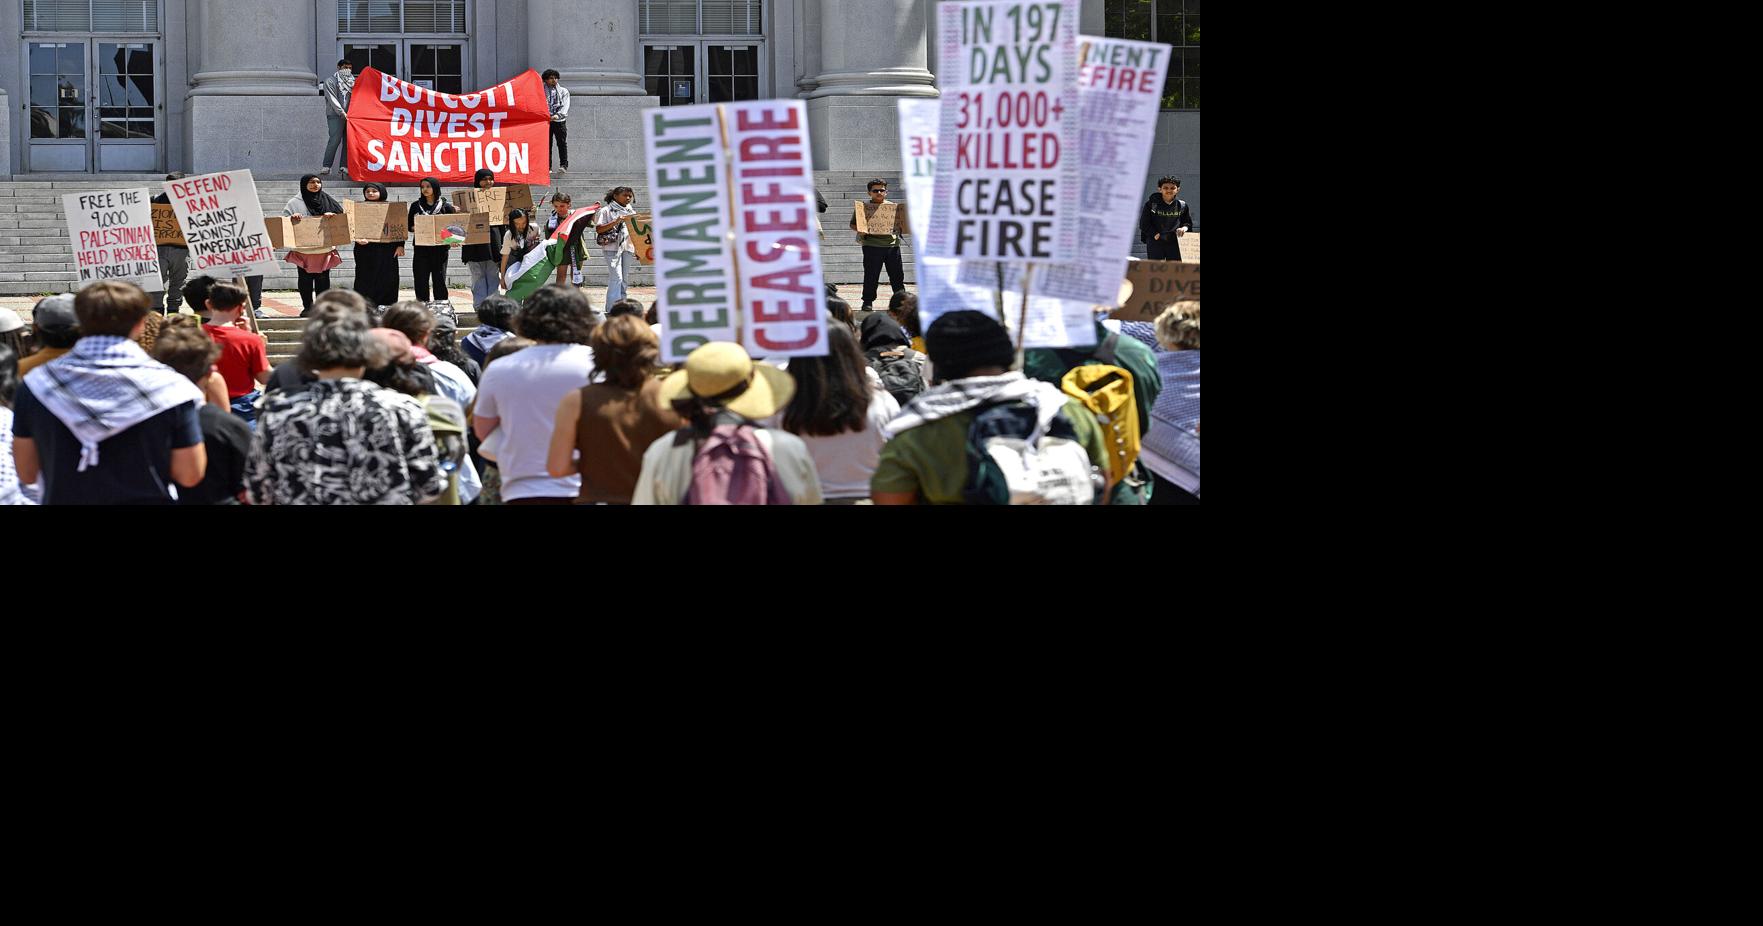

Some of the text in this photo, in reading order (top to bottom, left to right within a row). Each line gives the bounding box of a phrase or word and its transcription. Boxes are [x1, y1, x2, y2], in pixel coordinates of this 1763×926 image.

[962, 4, 1061, 45] IN 197
[970, 45, 1053, 85] DAYS
[956, 90, 1065, 129] 31,000+
[390, 107, 507, 139] DIVEST
[367, 139, 530, 175] SANCTION
[956, 132, 1061, 170] KILLED
[171, 174, 231, 199] DEFEND
[957, 178, 1056, 217] CEASE
[79, 191, 141, 210] FREE THE
[185, 194, 219, 214] IRAN
[91, 210, 128, 228] 9,000
[187, 206, 238, 230] AGAINST
[736, 107, 820, 352] CEASEFIRE
[79, 225, 152, 250] PALESTINIAN
[193, 233, 263, 256] IMPERIALIST
[954, 219, 1053, 258] FIRE
[77, 244, 157, 267] HELD HOSTAGES
[197, 246, 273, 270] ONSLAUGHT!
[80, 260, 159, 280] IN ISRAELI JAILS
